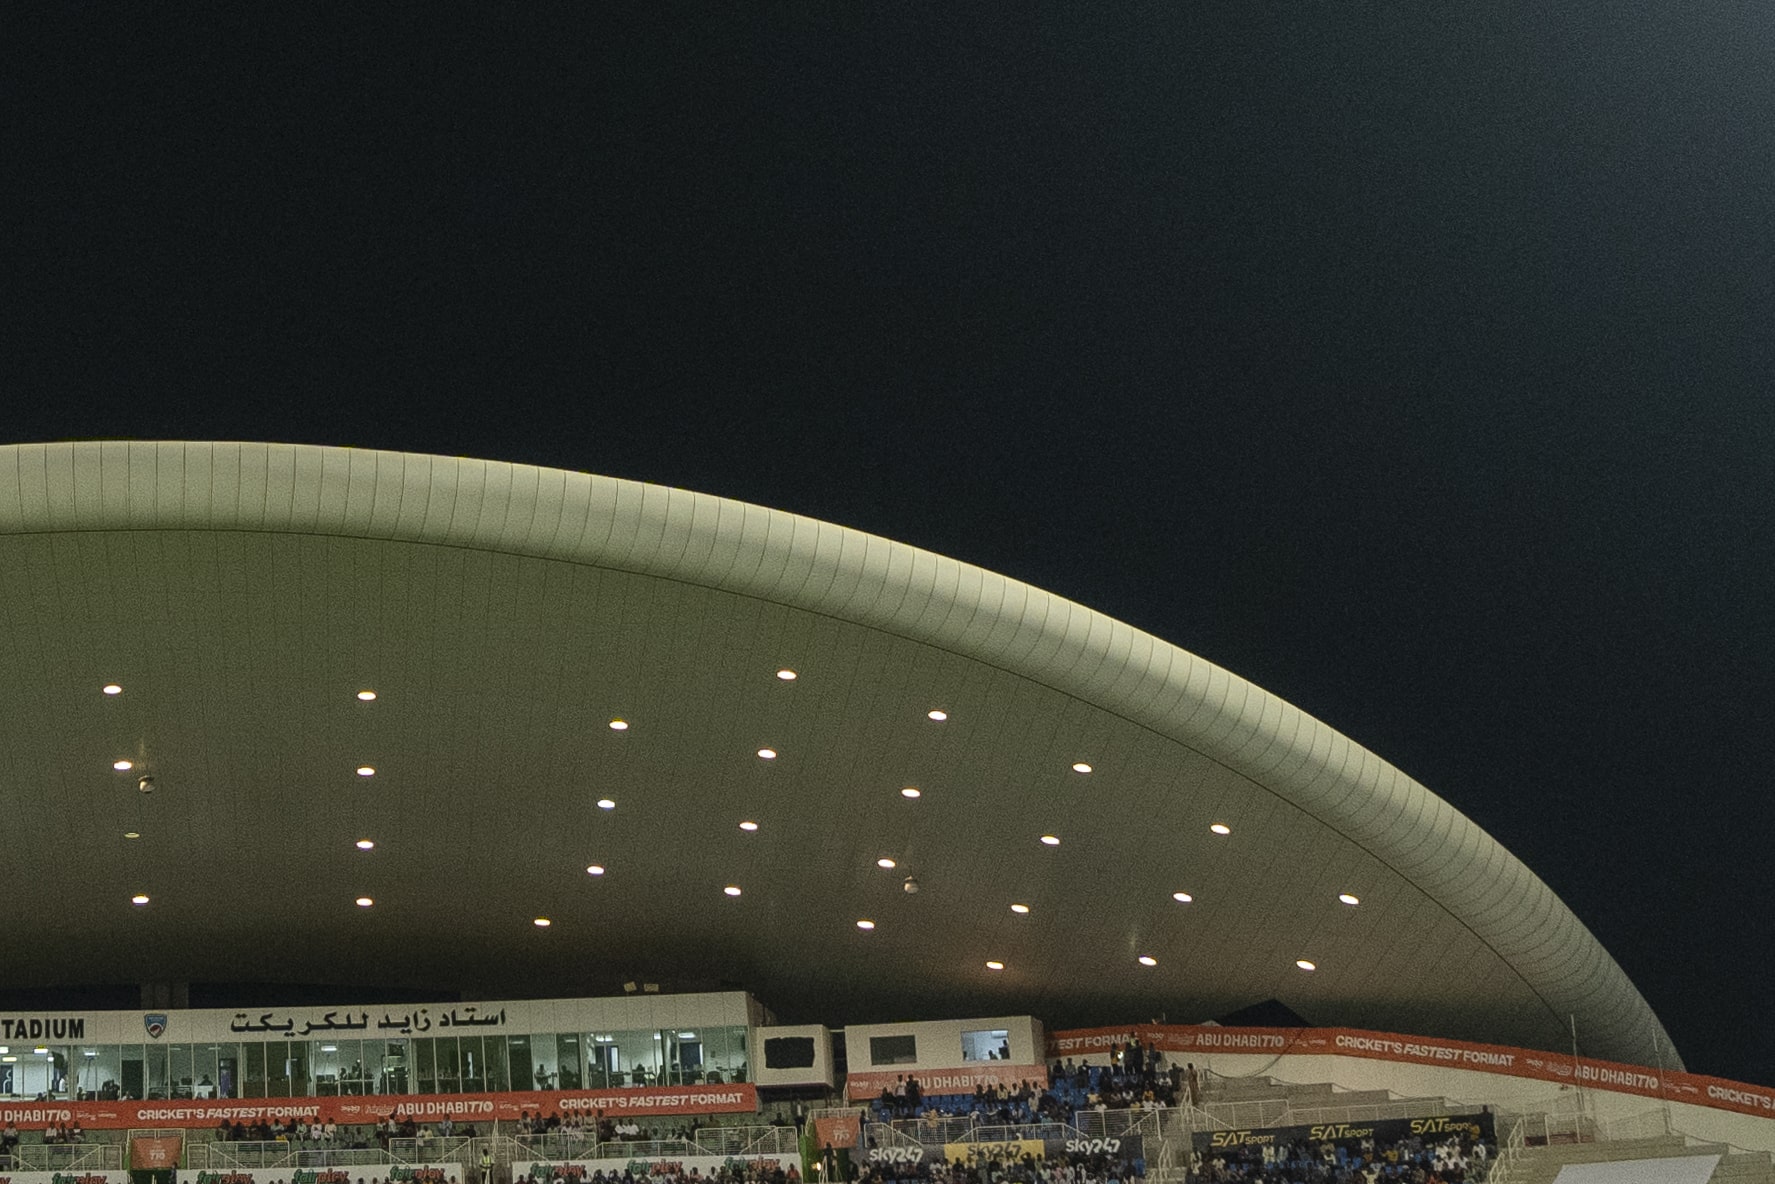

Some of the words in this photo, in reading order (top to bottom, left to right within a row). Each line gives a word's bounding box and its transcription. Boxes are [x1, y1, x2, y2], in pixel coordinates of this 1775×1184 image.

[230, 1011, 369, 1037] للكريكت
[378, 1008, 431, 1033] زايد
[438, 1007, 505, 1026] استاد
[1085, 1033, 1133, 1047] FORMA
[1197, 1034, 1221, 1047] ABU
[1336, 1035, 1402, 1053] CRICKET'S
[1402, 1044, 1462, 1061] FASTEST
[1462, 1050, 1513, 1067] FORMAT
[1574, 1064, 1598, 1081] ABU
[560, 1097, 627, 1109] CRICKET'S
[629, 1095, 688, 1107] FASTEST
[690, 1092, 743, 1105] FORMAT
[1707, 1085, 1771, 1109] CRICKET'S
[138, 1108, 205, 1120] CRICKET'S
[206, 1107, 265, 1119] FASTEST
[267, 1105, 320, 1118] FORMAT
[397, 1102, 424, 1115] ABU
